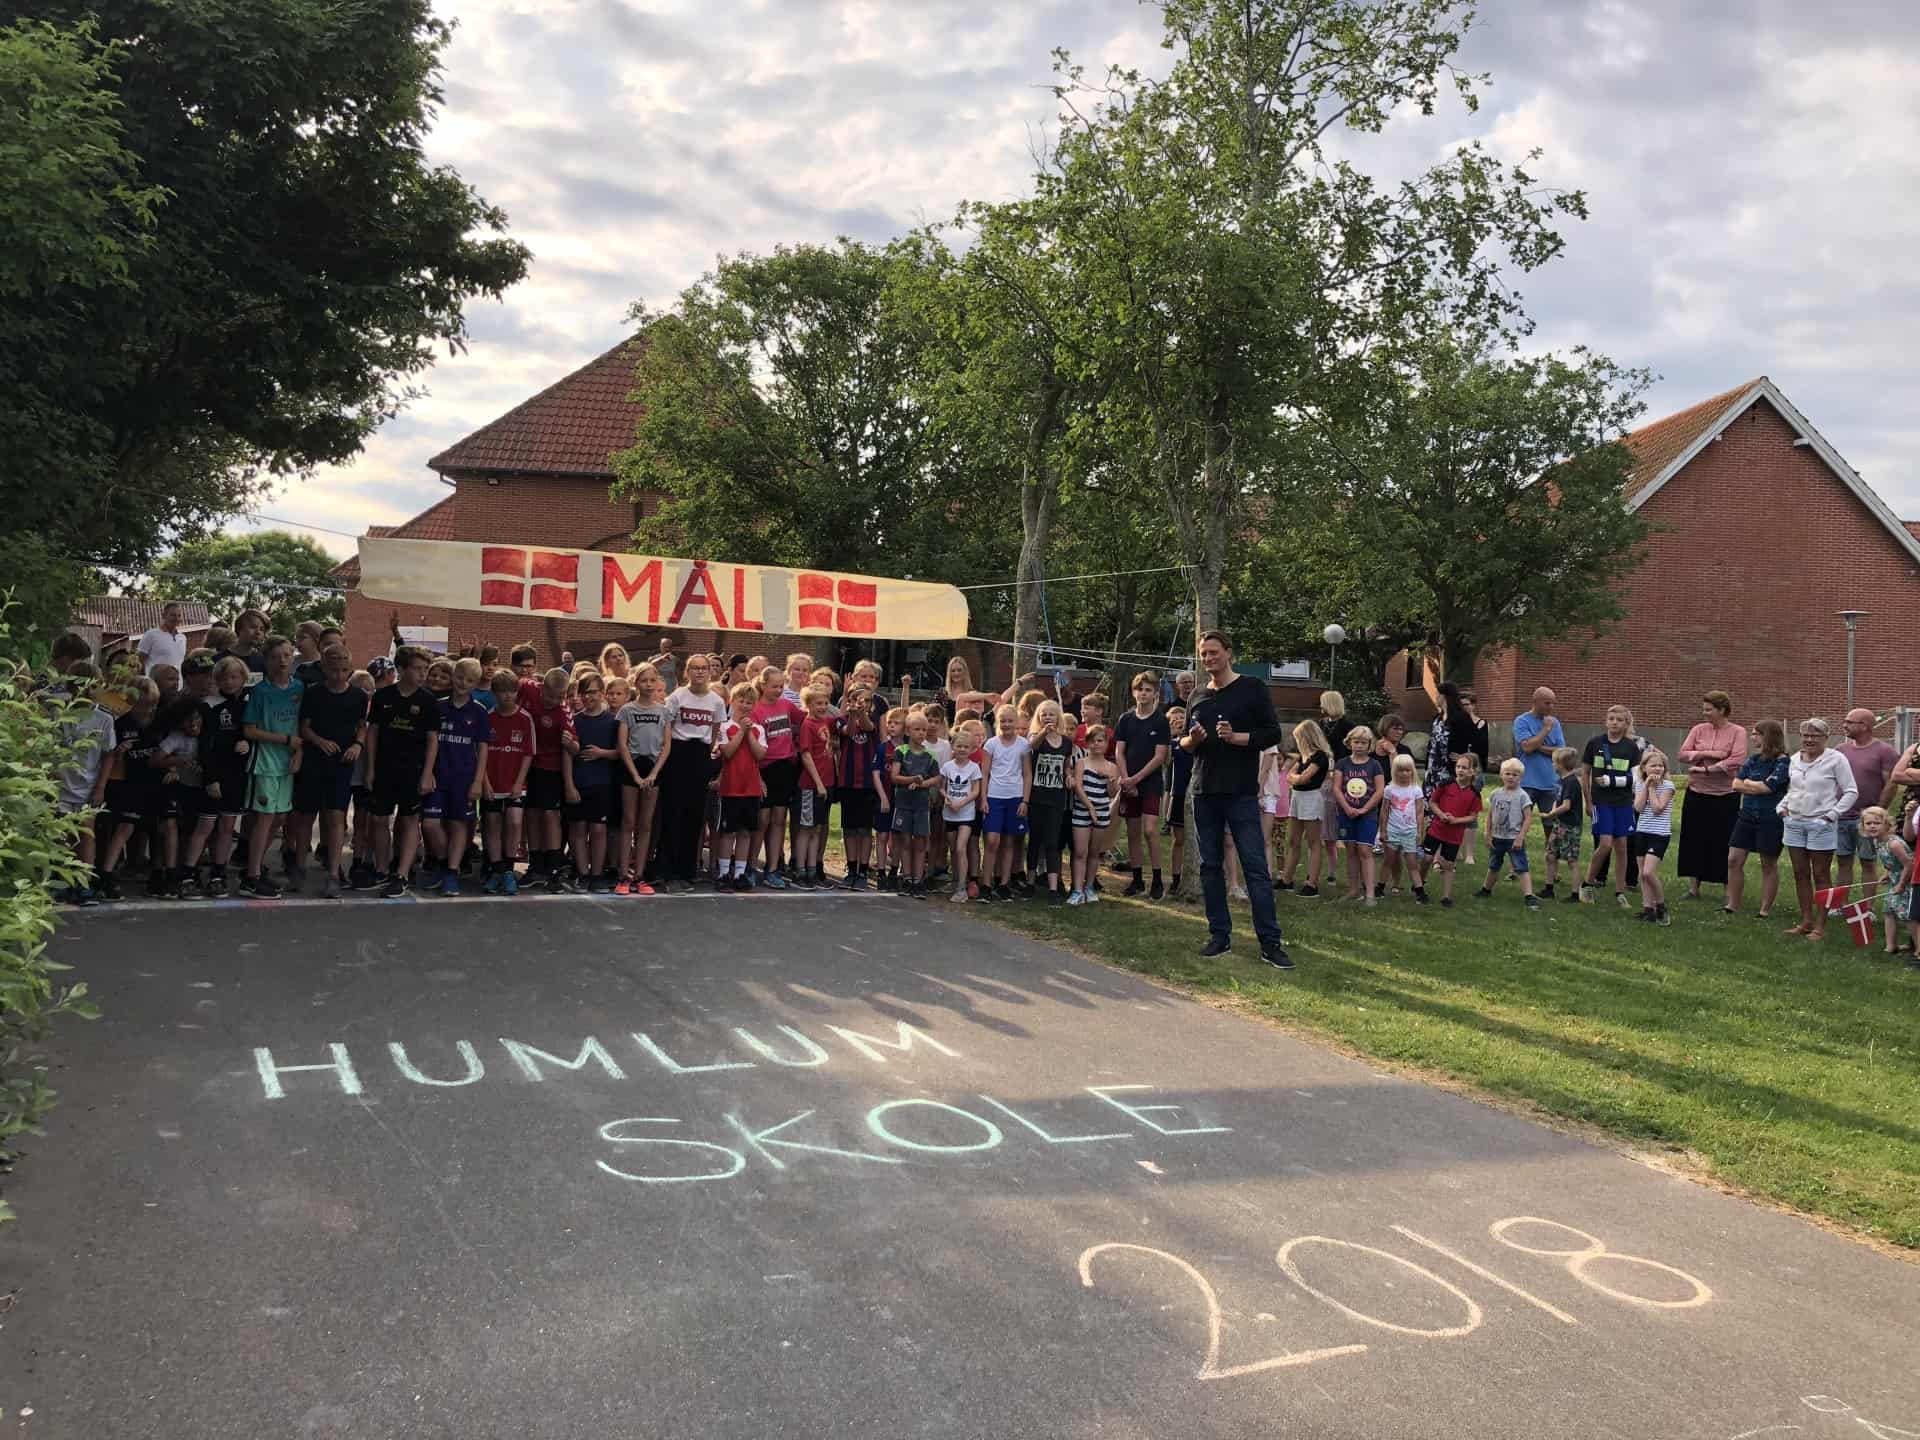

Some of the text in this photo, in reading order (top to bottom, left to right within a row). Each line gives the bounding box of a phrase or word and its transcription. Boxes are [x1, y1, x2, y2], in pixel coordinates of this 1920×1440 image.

[601, 556, 763, 630] MÅL
[253, 1021, 960, 1098] HUMLUM
[596, 1084, 1231, 1182] SKOLE
[1078, 1215, 1714, 1380] 2018
